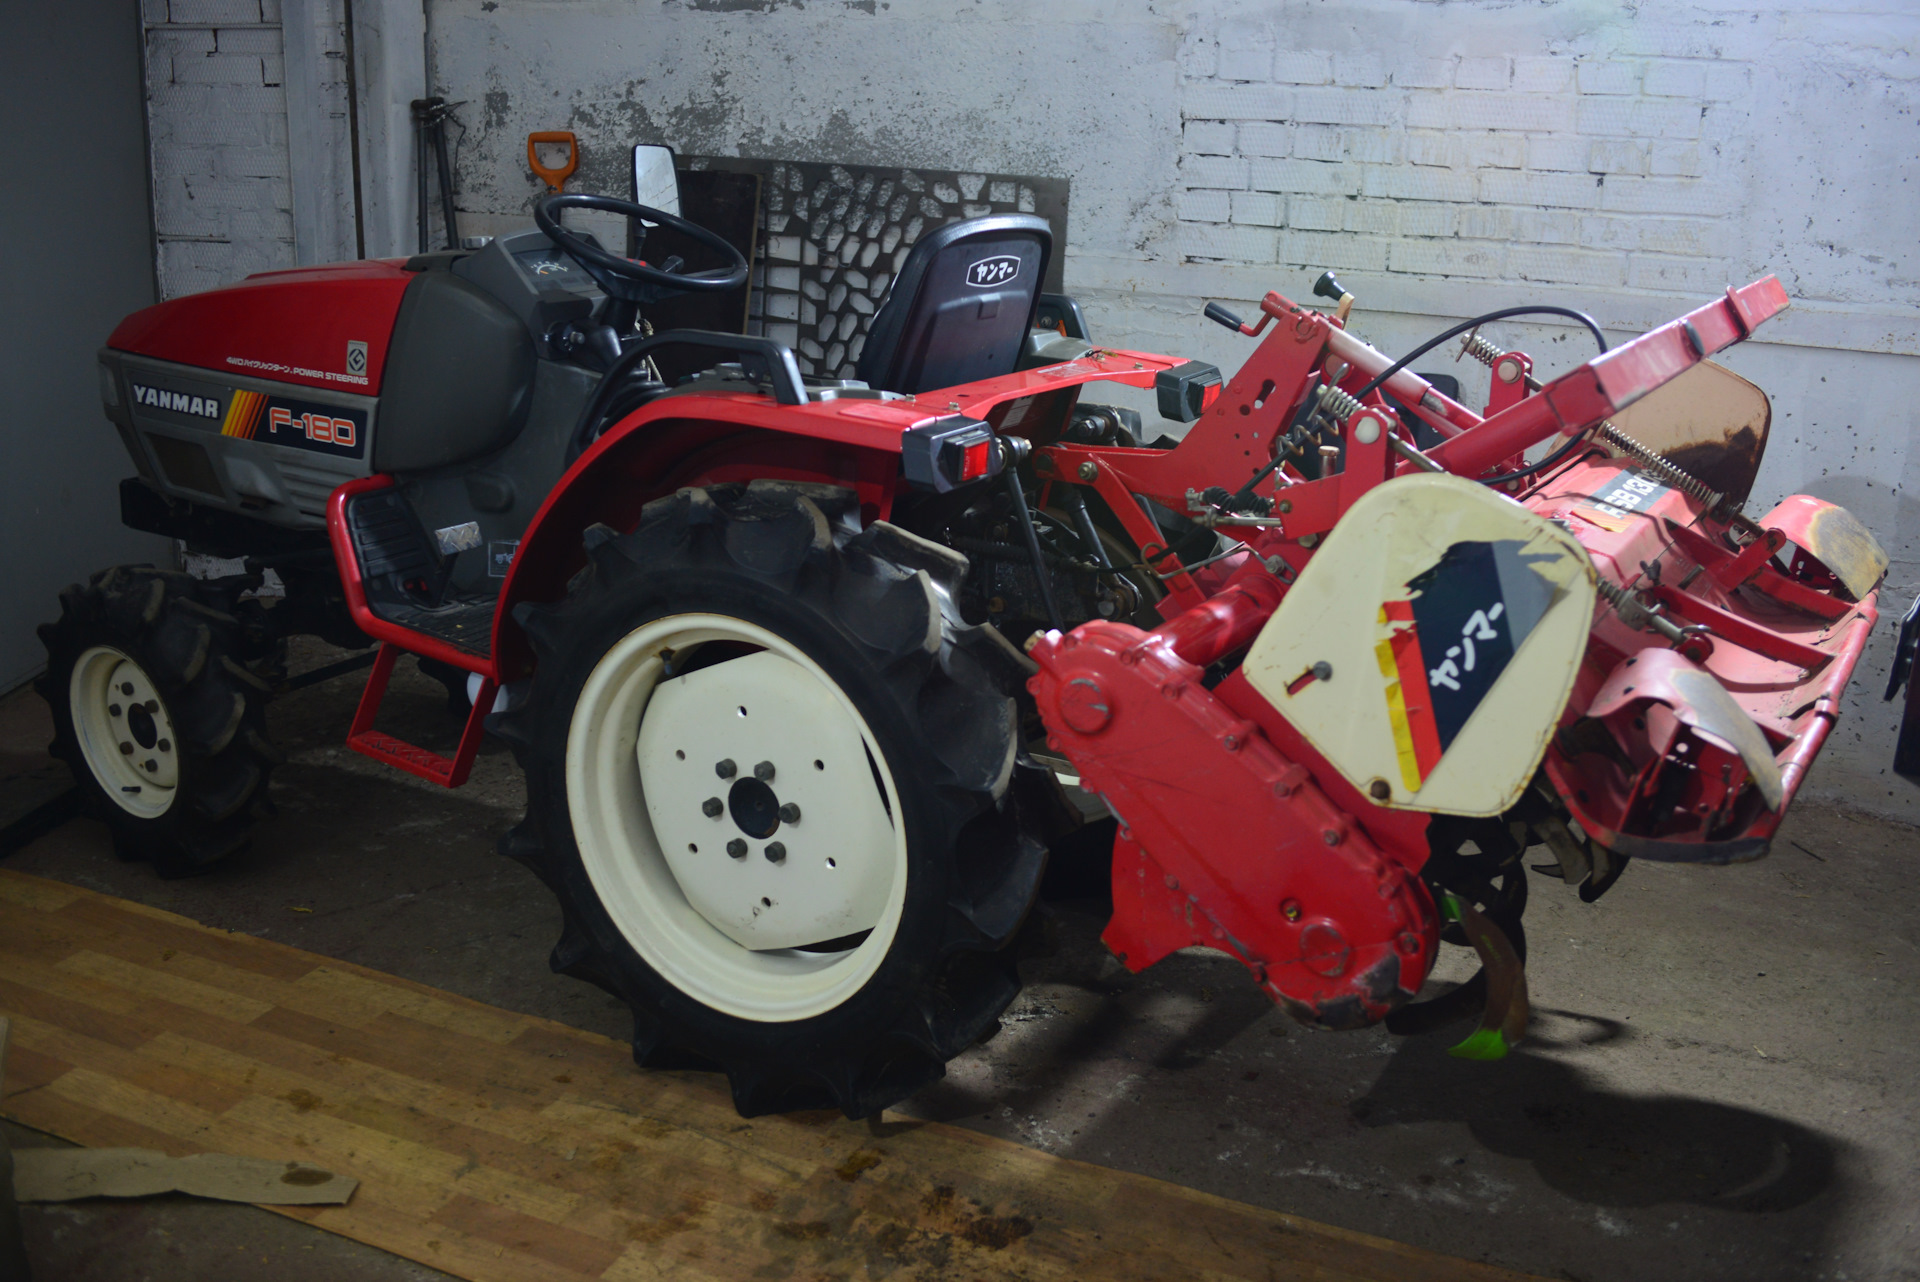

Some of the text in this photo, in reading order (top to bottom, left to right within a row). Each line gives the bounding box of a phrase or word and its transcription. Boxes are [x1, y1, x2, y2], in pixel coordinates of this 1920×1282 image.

[977, 262, 1014, 283] ヤンマー
[293, 367, 325, 379] POWER
[325, 372, 369, 386] STEERING
[133, 384, 219, 419] YANMAR
[269, 406, 356, 448] F-180
[1429, 602, 1504, 691] ヤンマー
